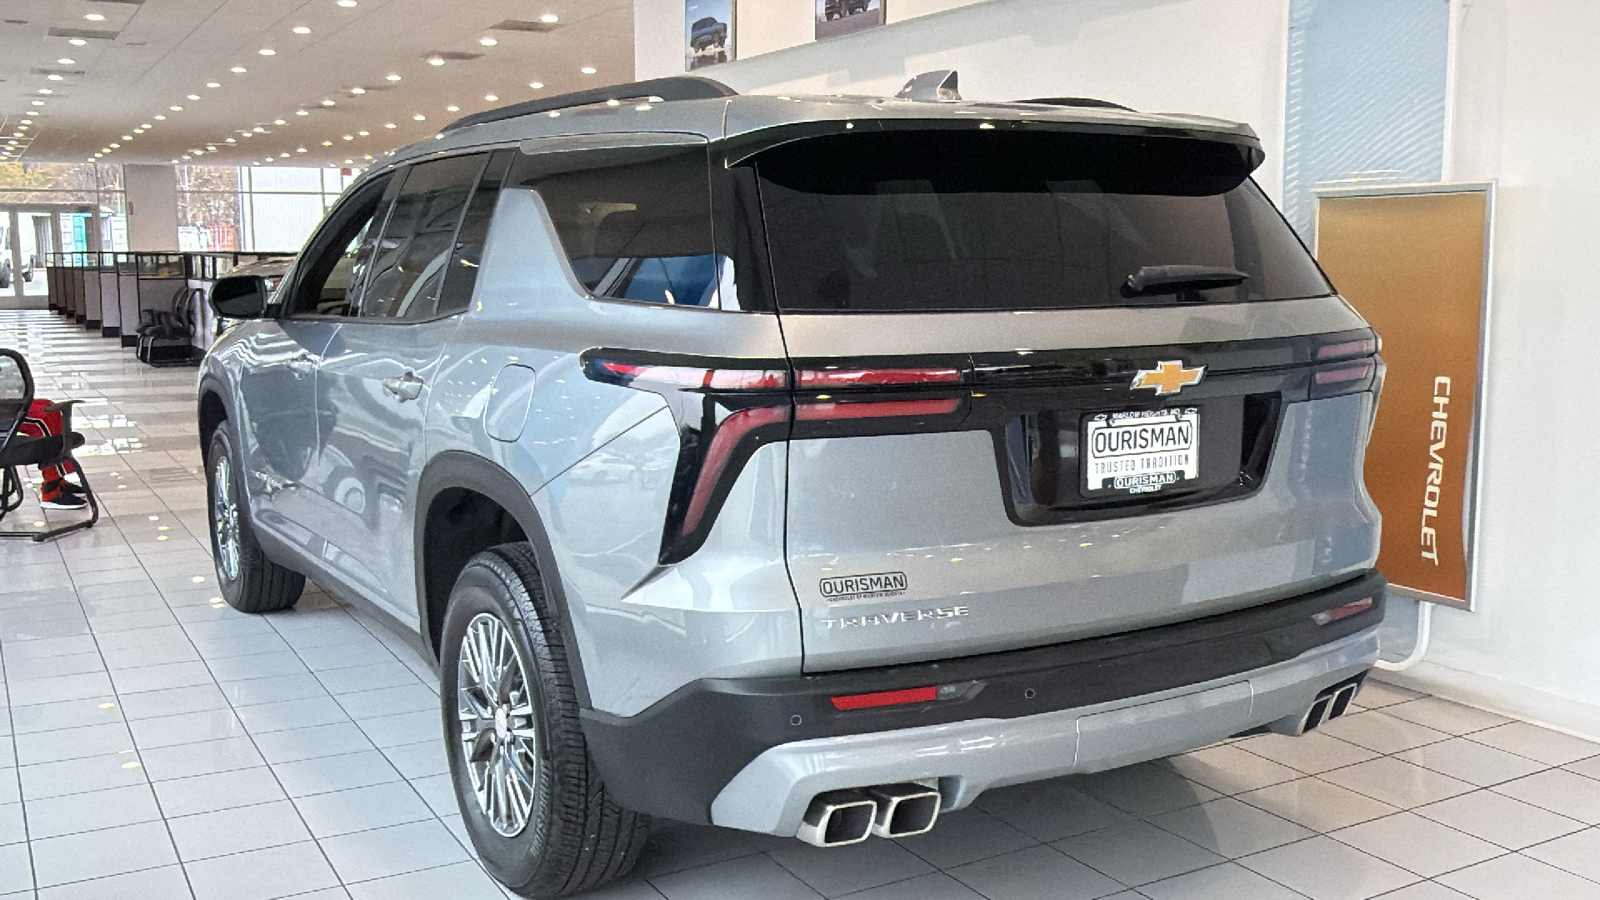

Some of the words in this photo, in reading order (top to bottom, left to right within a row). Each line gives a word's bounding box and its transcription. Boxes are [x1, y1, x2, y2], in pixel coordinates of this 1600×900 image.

[1095, 425, 1189, 453] OURISMAN
[1095, 460, 1136, 474] TRUSTED
[1421, 376, 1451, 566] CHEVROLET
[1116, 473, 1174, 487] OURISMAN
[822, 575, 905, 595] OURISMAN
[820, 606, 970, 629] TRAVERSE
